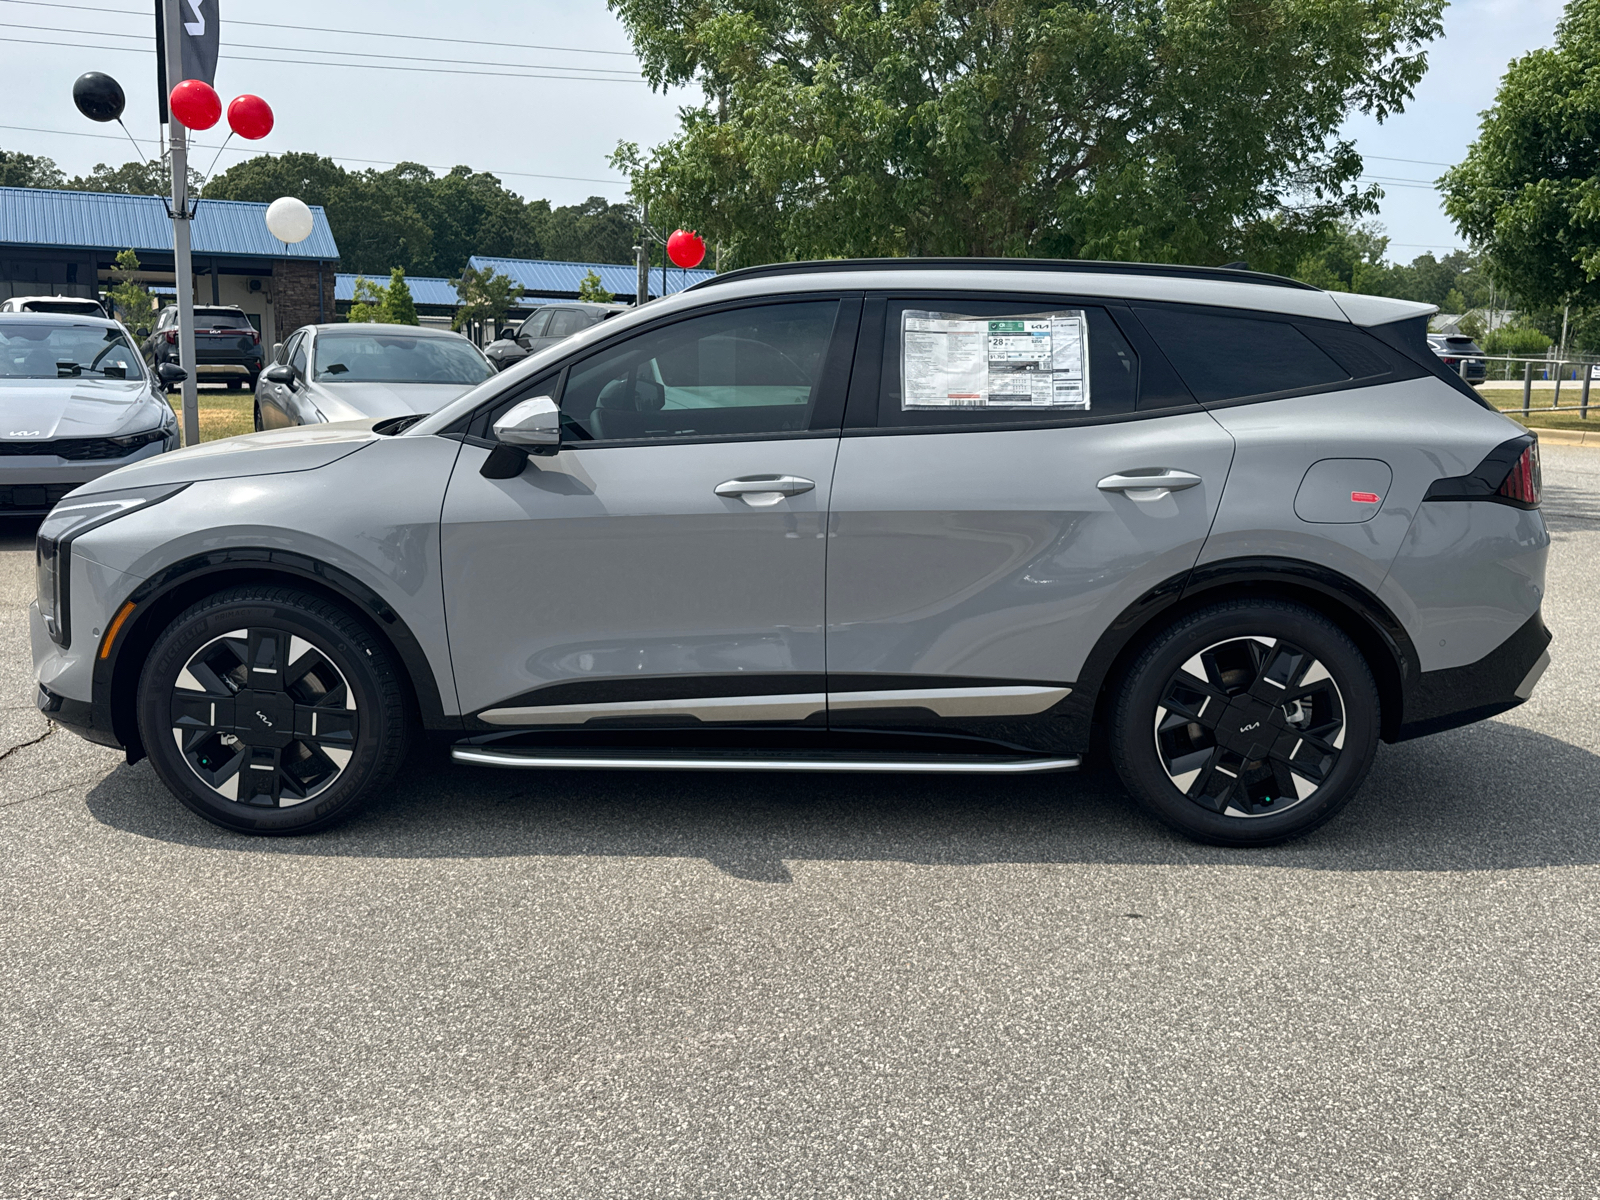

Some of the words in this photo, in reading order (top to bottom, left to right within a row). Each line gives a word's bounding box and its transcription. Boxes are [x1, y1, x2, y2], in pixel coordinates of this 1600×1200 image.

[993, 338, 1004, 346] 28
[158, 620, 206, 676] MICHELIN
[255, 710, 273, 727] KIA
[1239, 721, 1260, 733] KIA
